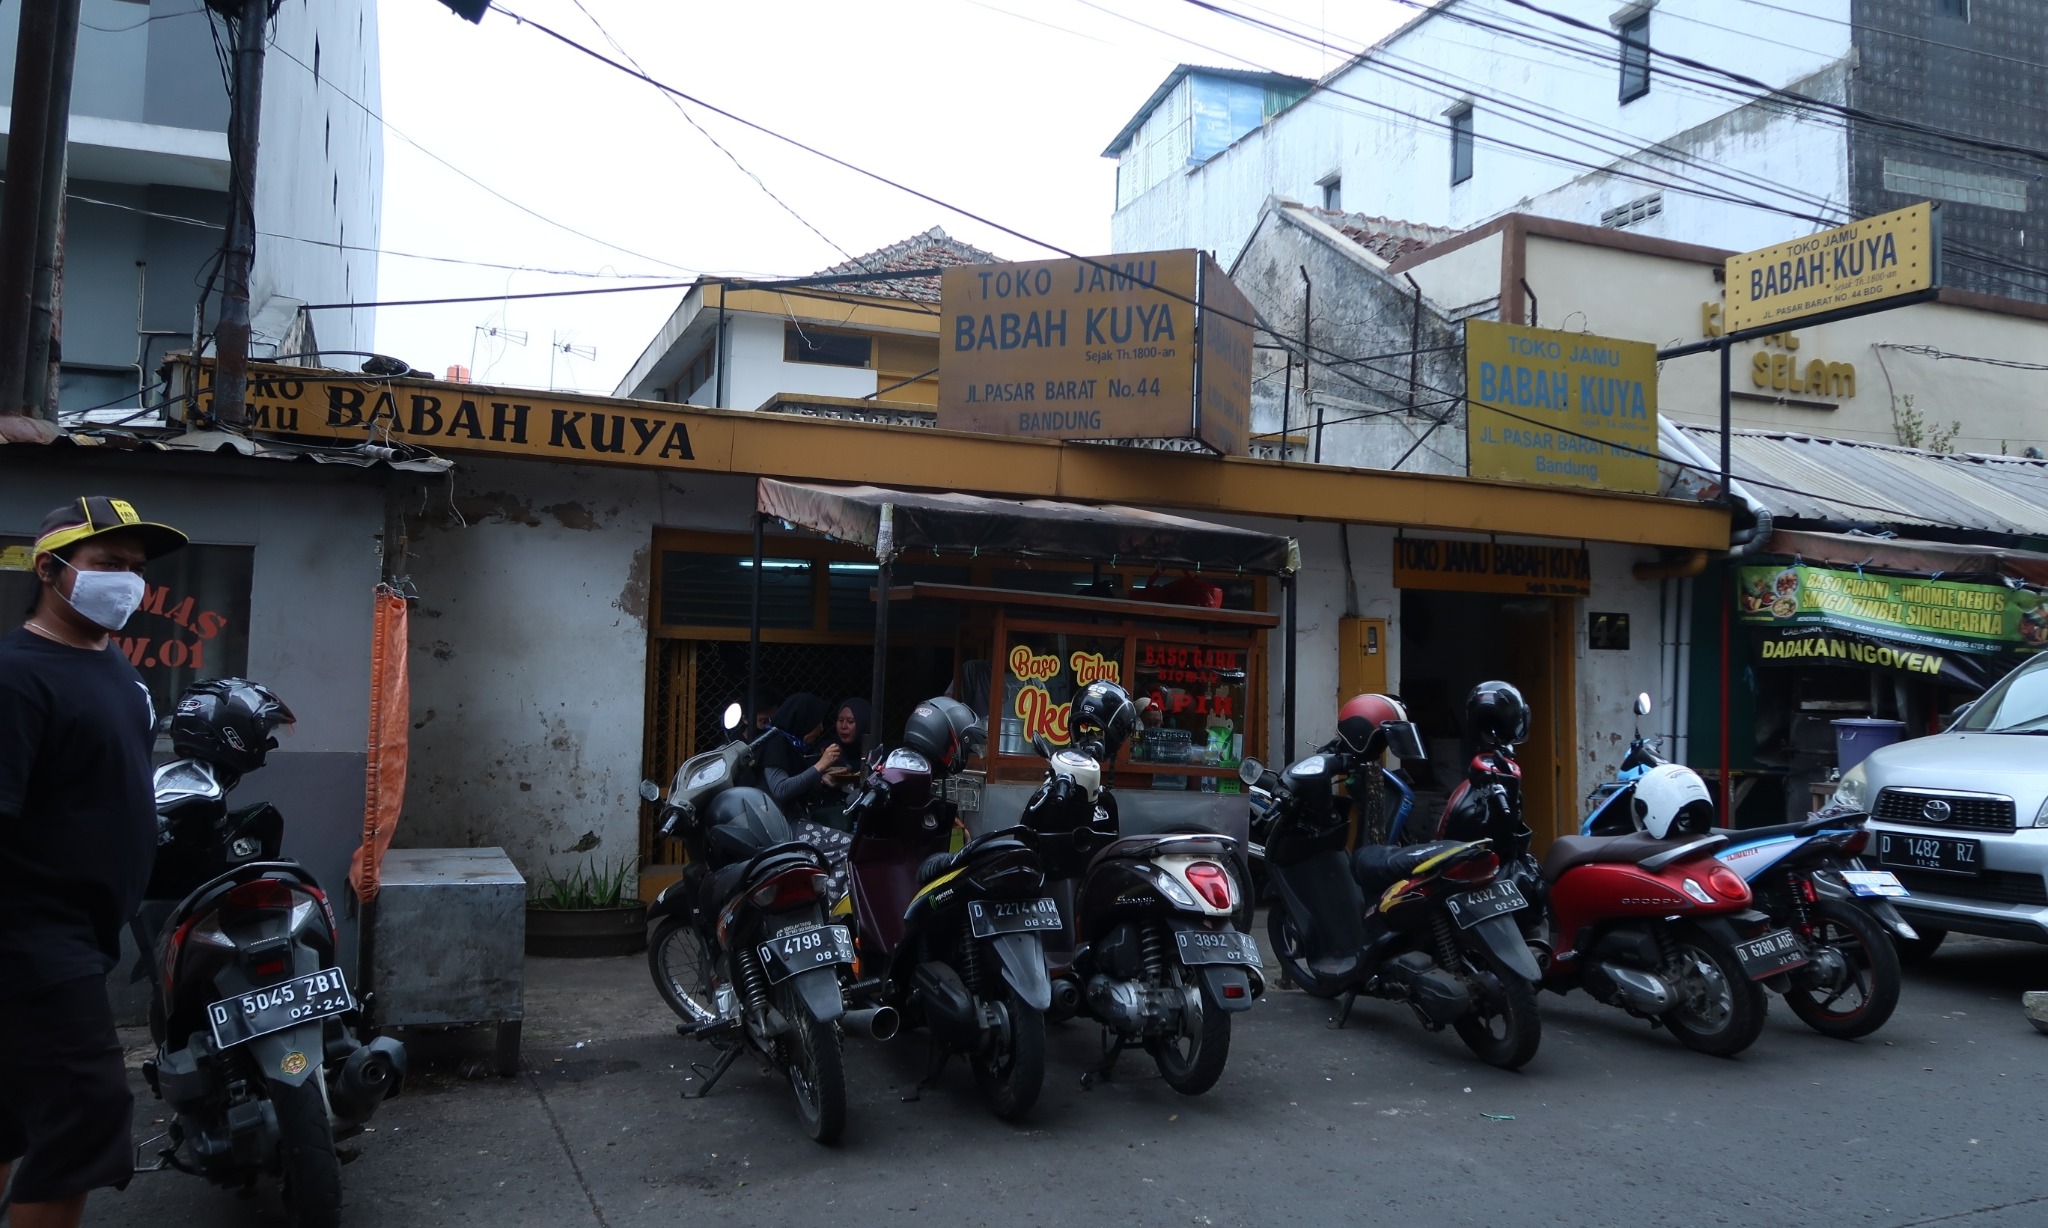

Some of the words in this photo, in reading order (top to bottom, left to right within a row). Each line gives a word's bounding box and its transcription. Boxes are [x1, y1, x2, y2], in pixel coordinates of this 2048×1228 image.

[1787, 239, 1819, 257] TOKO
[1823, 228, 1858, 248] JAMU
[978, 268, 1051, 300] TOKO
[1073, 260, 1157, 294] JAMU
[1751, 251, 1825, 302] BABAH
[1834, 232, 1898, 280] KUYA
[1776, 303, 1804, 317] PASAR
[1804, 297, 1833, 310] BARAT
[1852, 290, 1862, 300] 44
[1863, 285, 1883, 298] BDG
[955, 308, 1067, 352] BABAH
[1085, 304, 1176, 347] KUYA
[1086, 350, 1113, 364] Sejak
[1508, 336, 1561, 359] TOKO
[1568, 346, 1620, 368] JAMU
[203, 368, 304, 401] TKO
[1045, 380, 1097, 402] BARAT
[1479, 361, 1569, 411] BABAH
[1581, 375, 1647, 420] KUYA
[327, 386, 531, 444] BABAH
[548, 409, 695, 461] KUYA
[1019, 410, 1101, 432] BANDUNG
[1480, 427, 1500, 444] JL.
[1504, 429, 1553, 450] PASAR
[1558, 434, 1604, 456] BARAT
[1536, 455, 1599, 482] Bandung
[1396, 539, 1439, 571] TOKO
[1443, 541, 1489, 574] JAMU
[1494, 543, 1546, 578] BABAH
[1550, 547, 1591, 581] KUYA
[1806, 573, 1842, 592] BASO
[1902, 585, 1955, 607] INDOMIE
[1957, 590, 2005, 612] REBUS
[1802, 588, 1851, 613] SANGU
[1849, 598, 1904, 623] TIMBEL
[1906, 605, 2004, 635] SINGAPARNA
[1592, 616, 1627, 647] 44
[1011, 647, 1059, 680] Baso
[1072, 653, 1118, 685] Tahu
[1762, 638, 1847, 658] DADAKAN
[1850, 642, 1943, 675] NGOVEN
[1882, 835, 1890, 853] D
[1908, 839, 1940, 859] 1482
[1956, 843, 1975, 863] RZ
[974, 904, 983, 918] D
[1450, 900, 1461, 914] D
[1468, 888, 1496, 905] 4332
[761, 946, 772, 963] D
[784, 933, 821, 954] 4798
[834, 929, 850, 944] SZ
[1179, 935, 1188, 947] D
[1194, 933, 1228, 947] 3892
[1738, 948, 1749, 961] D
[214, 1007, 228, 1025] D
[242, 985, 295, 1014] 5045
[304, 971, 341, 998] ZBI
